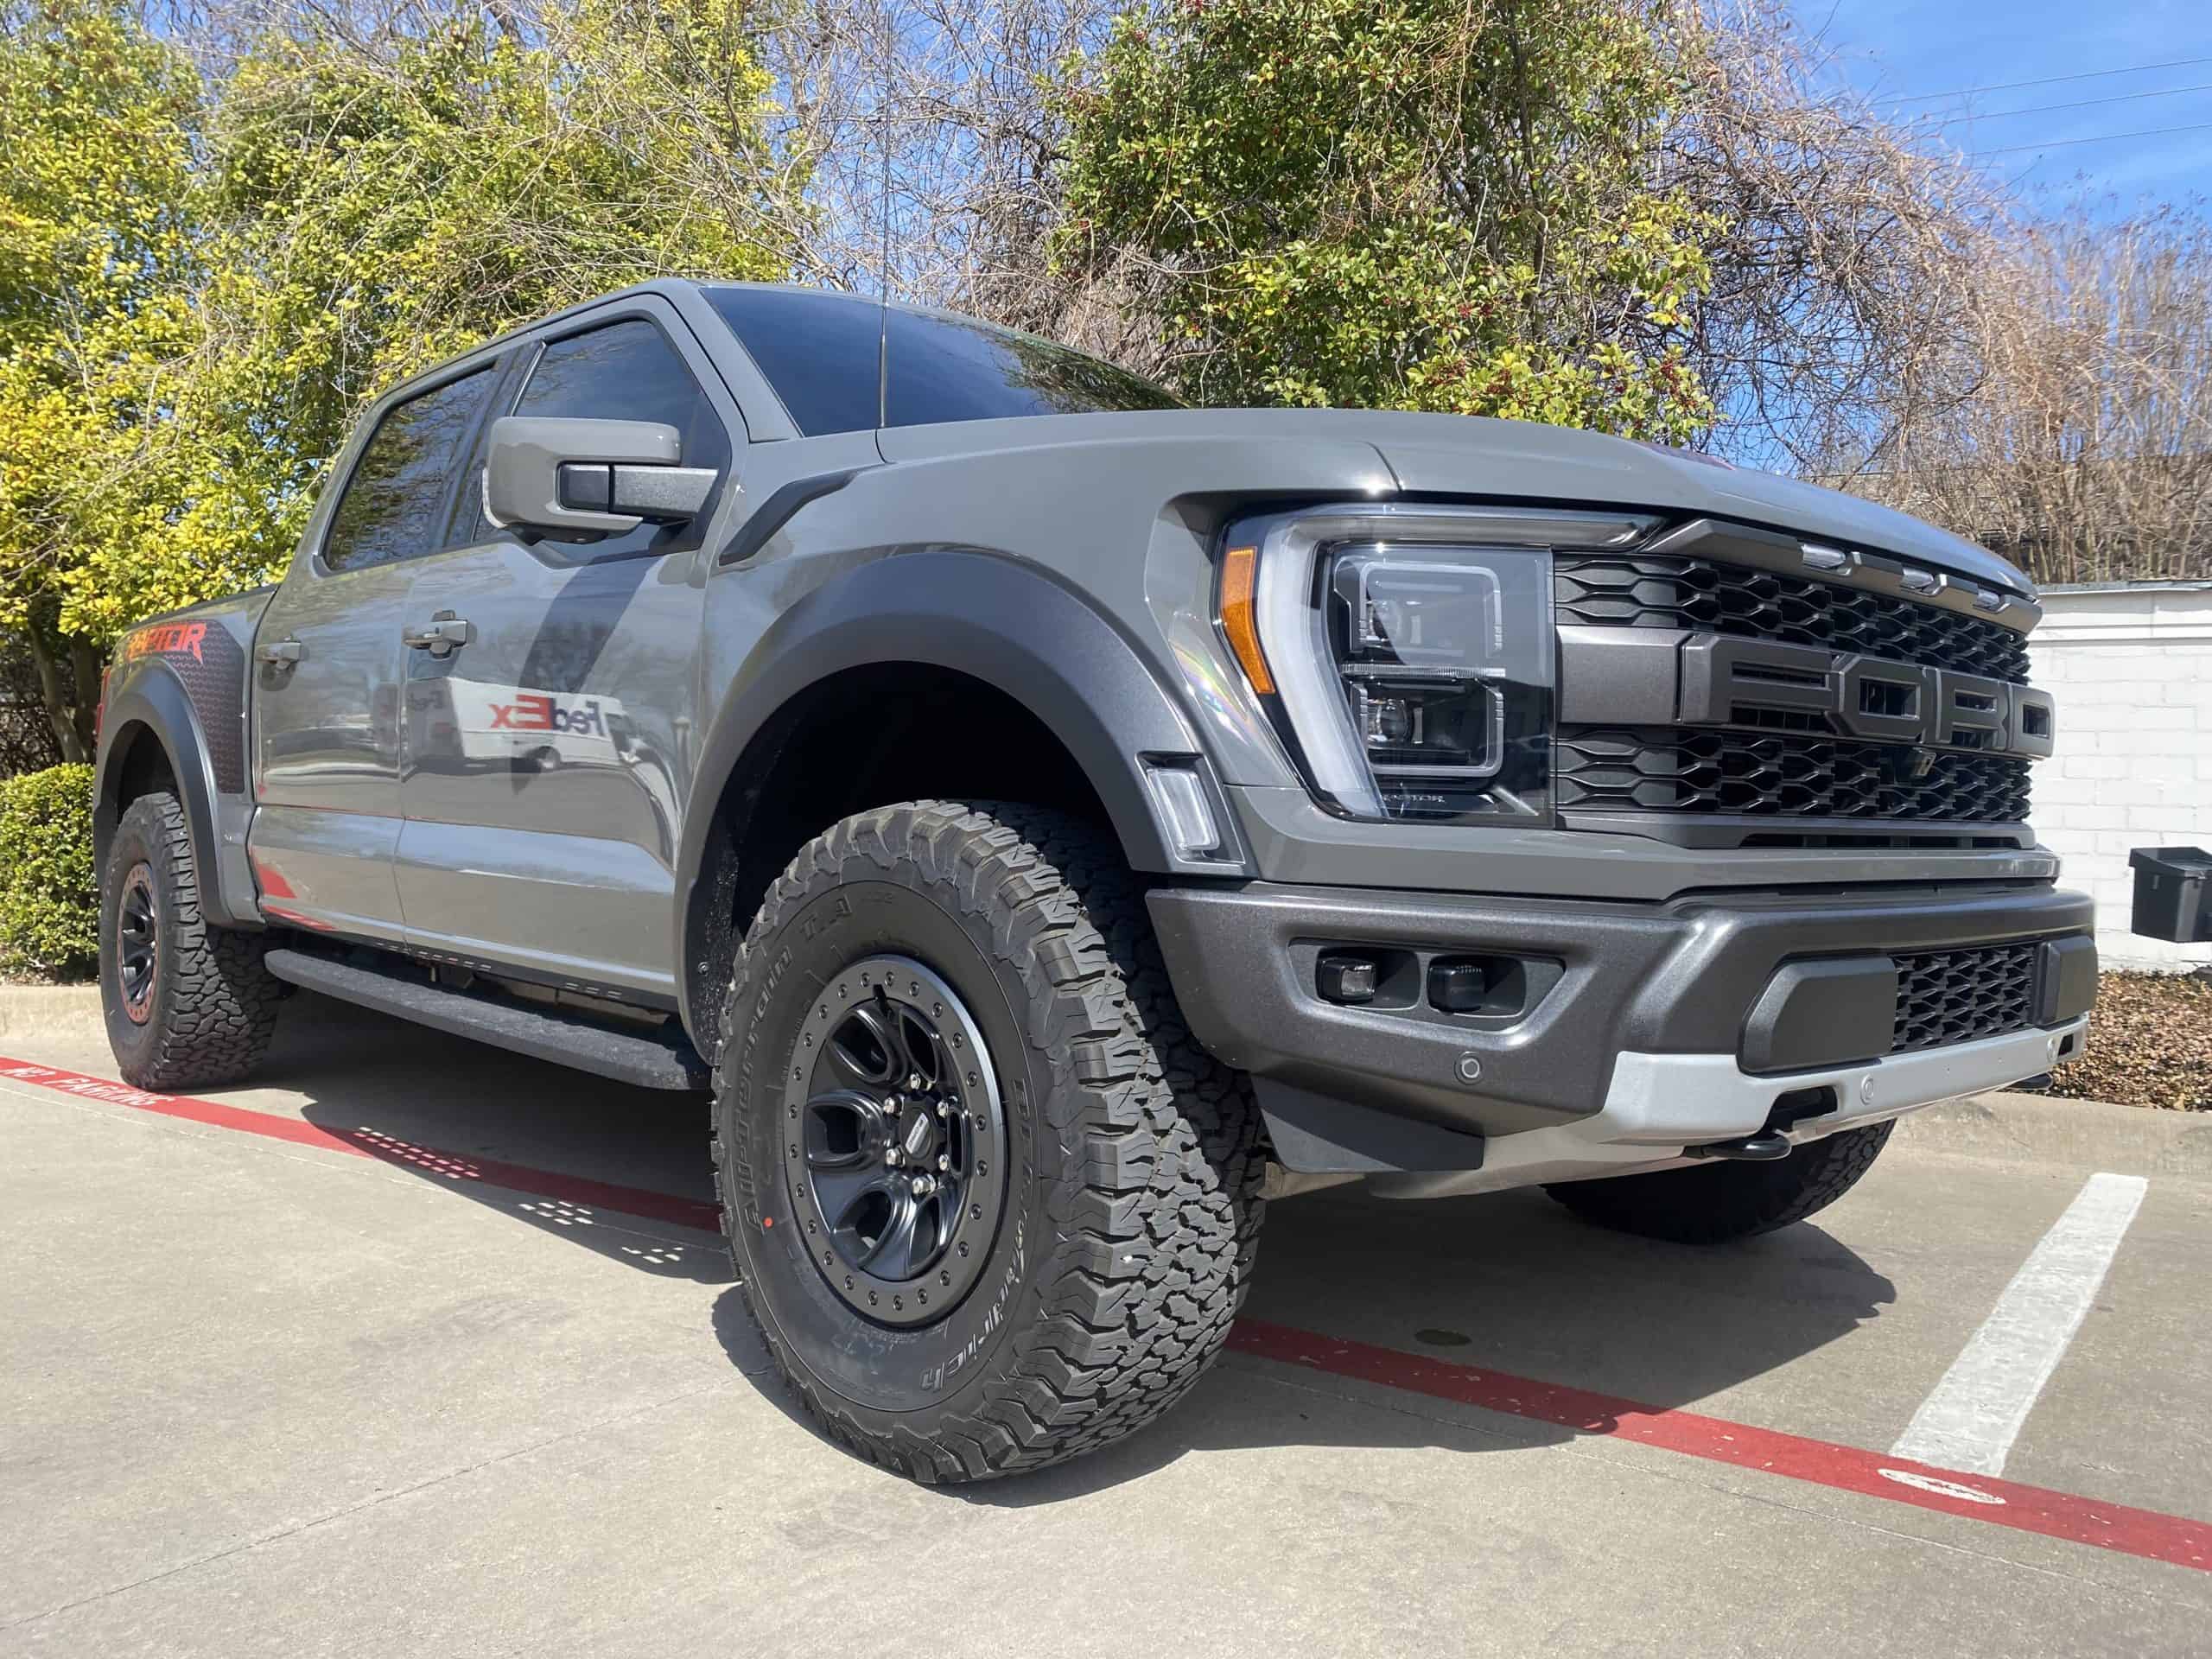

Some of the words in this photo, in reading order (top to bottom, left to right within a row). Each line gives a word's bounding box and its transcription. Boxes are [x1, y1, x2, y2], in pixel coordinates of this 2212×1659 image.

[125, 621, 207, 664] RAPTOR
[1675, 634, 2056, 759] FORD
[43, 1077, 176, 1106] PARKING
